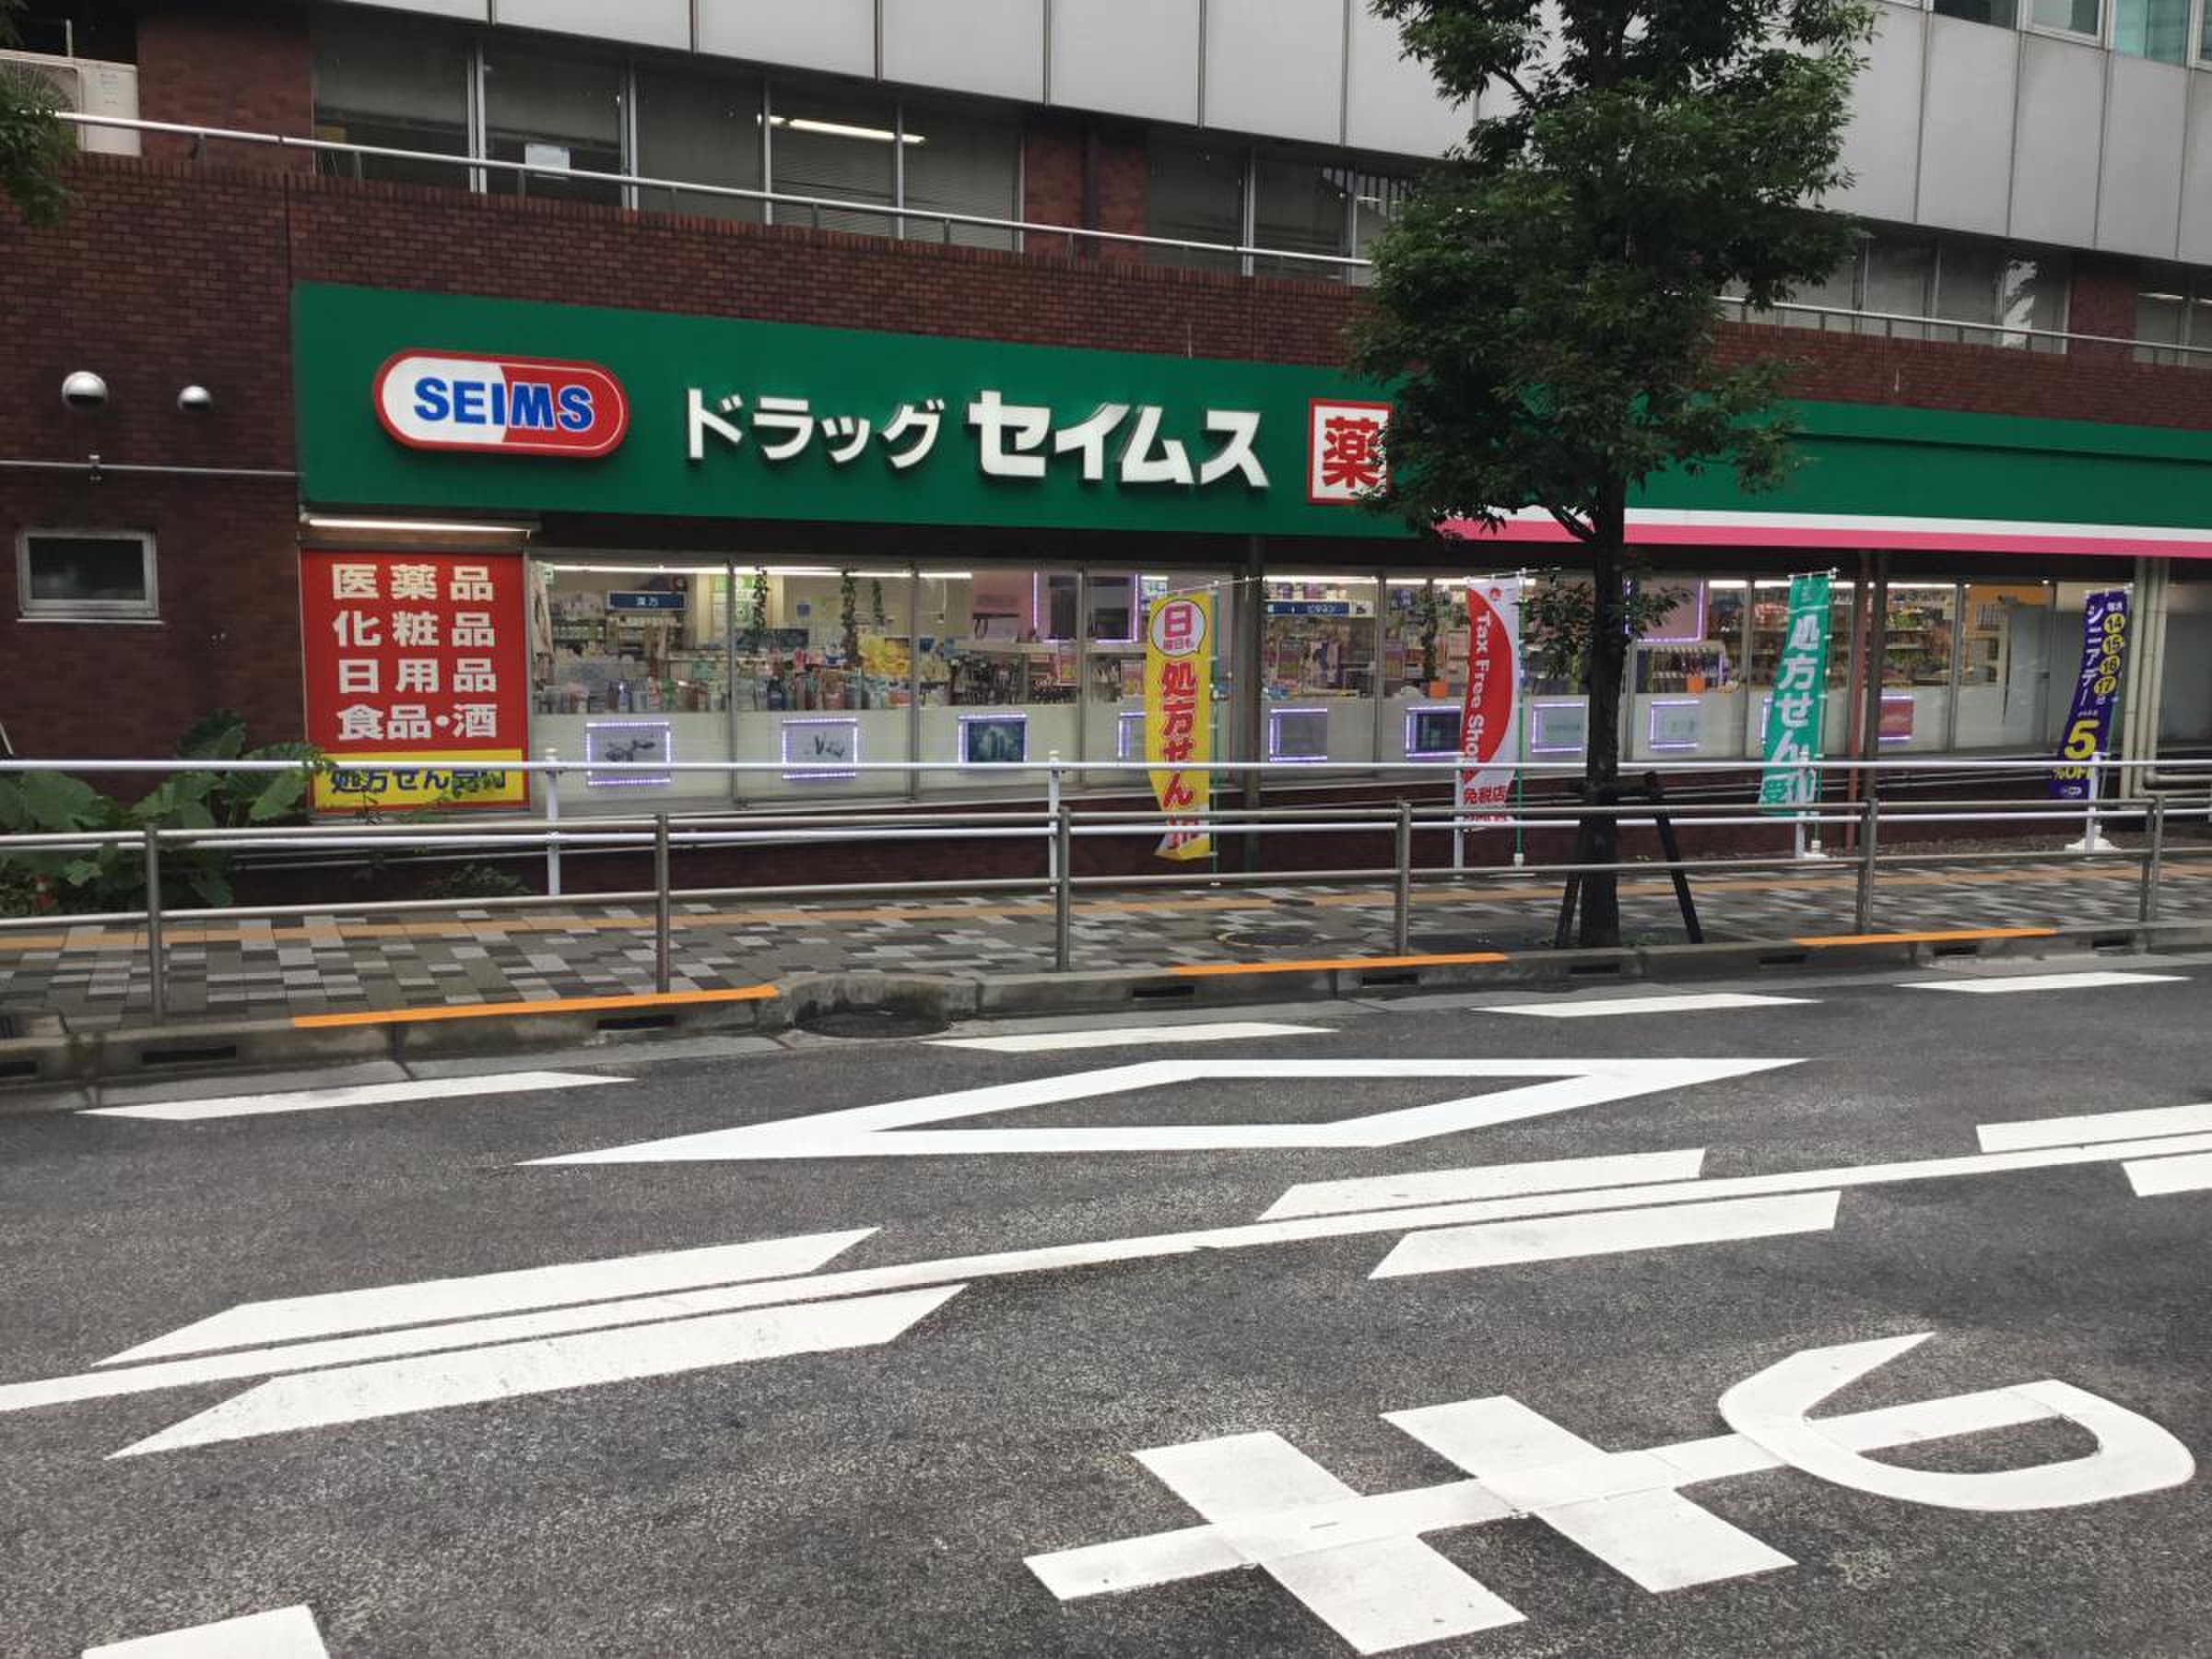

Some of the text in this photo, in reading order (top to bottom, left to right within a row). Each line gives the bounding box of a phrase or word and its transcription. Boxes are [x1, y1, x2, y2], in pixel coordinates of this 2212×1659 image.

[413, 376, 596, 433] SEIMS
[688, 388, 1272, 488] ドラッグ セイムス
[1322, 416, 1380, 489] 薬
[332, 563, 494, 601] 医薬品
[333, 610, 496, 648] 化粧品
[338, 657, 498, 693] 日用品
[2079, 605, 2104, 707] シニアデー
[1460, 610, 1491, 765] Tax Free Sho
[336, 703, 499, 741] 食品・酒
[2064, 719, 2100, 760] 5
